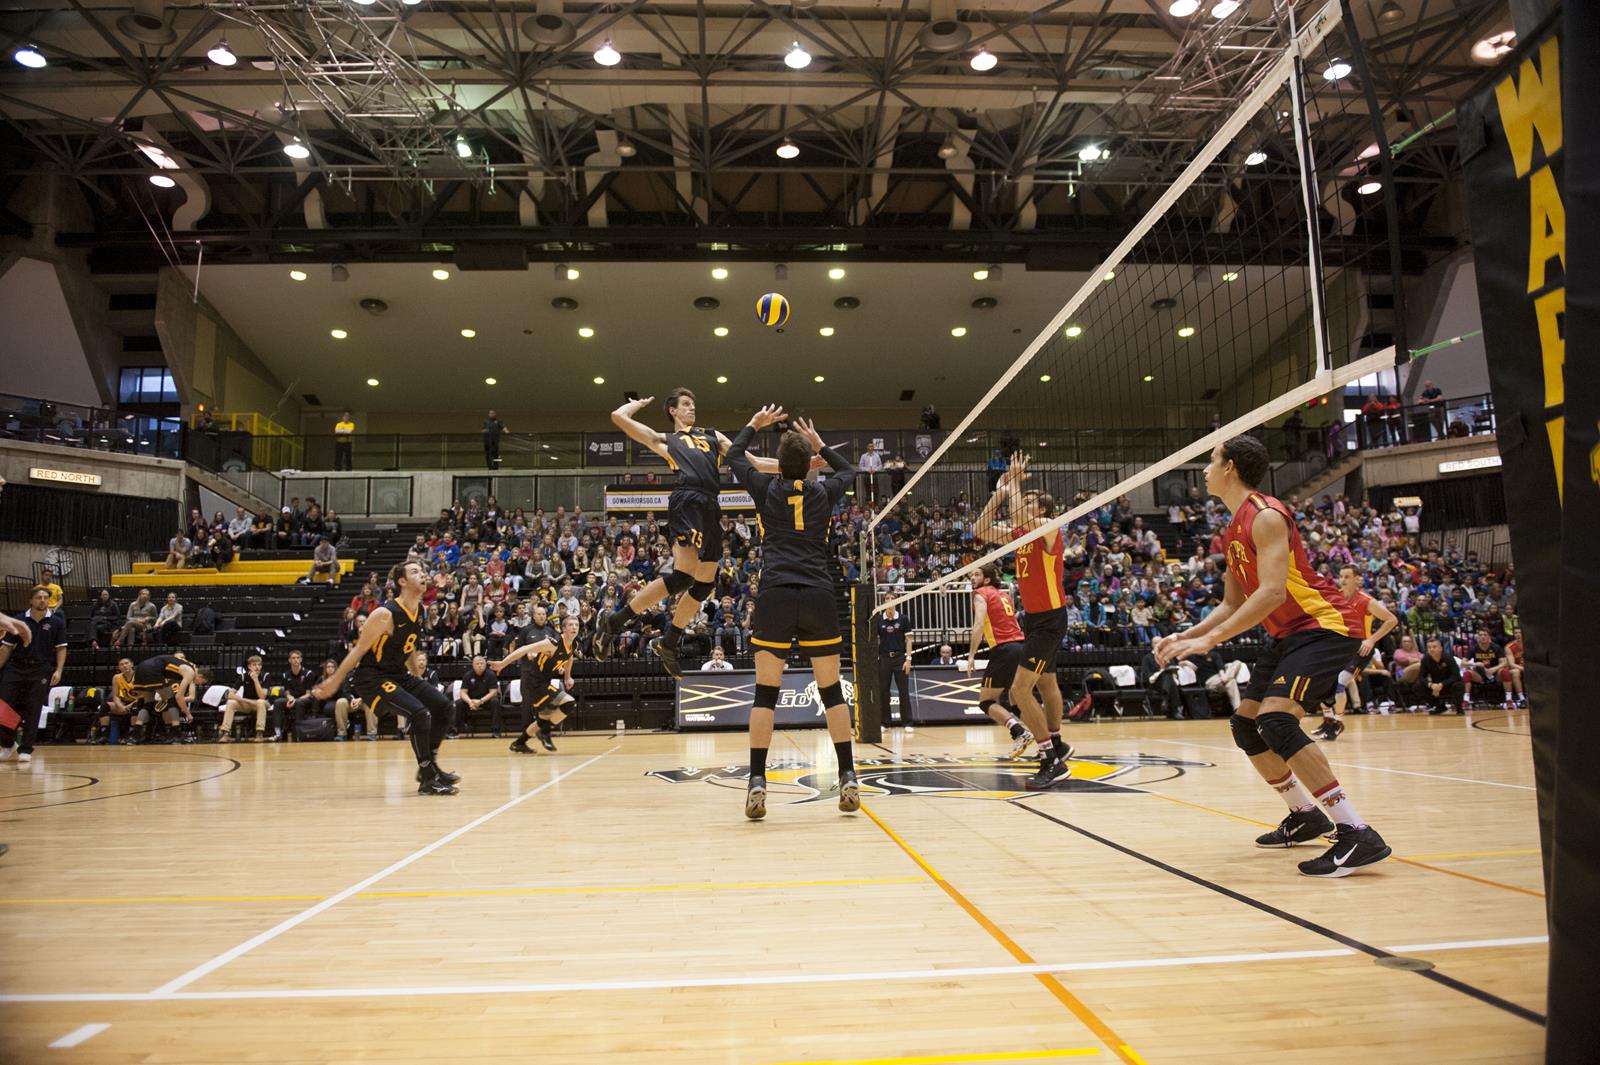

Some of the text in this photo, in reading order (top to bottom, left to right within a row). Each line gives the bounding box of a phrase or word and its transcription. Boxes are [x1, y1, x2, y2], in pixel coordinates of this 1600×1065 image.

[680, 434, 711, 453] 15
[36, 470, 96, 483] RED NORTH
[718, 495, 752, 503] LACKGOGOLD
[691, 528, 703, 548] 15
[1016, 557, 1029, 578] 12
[1001, 597, 1014, 617] 6
[403, 633, 417, 654] 8
[381, 681, 397, 693] 8
